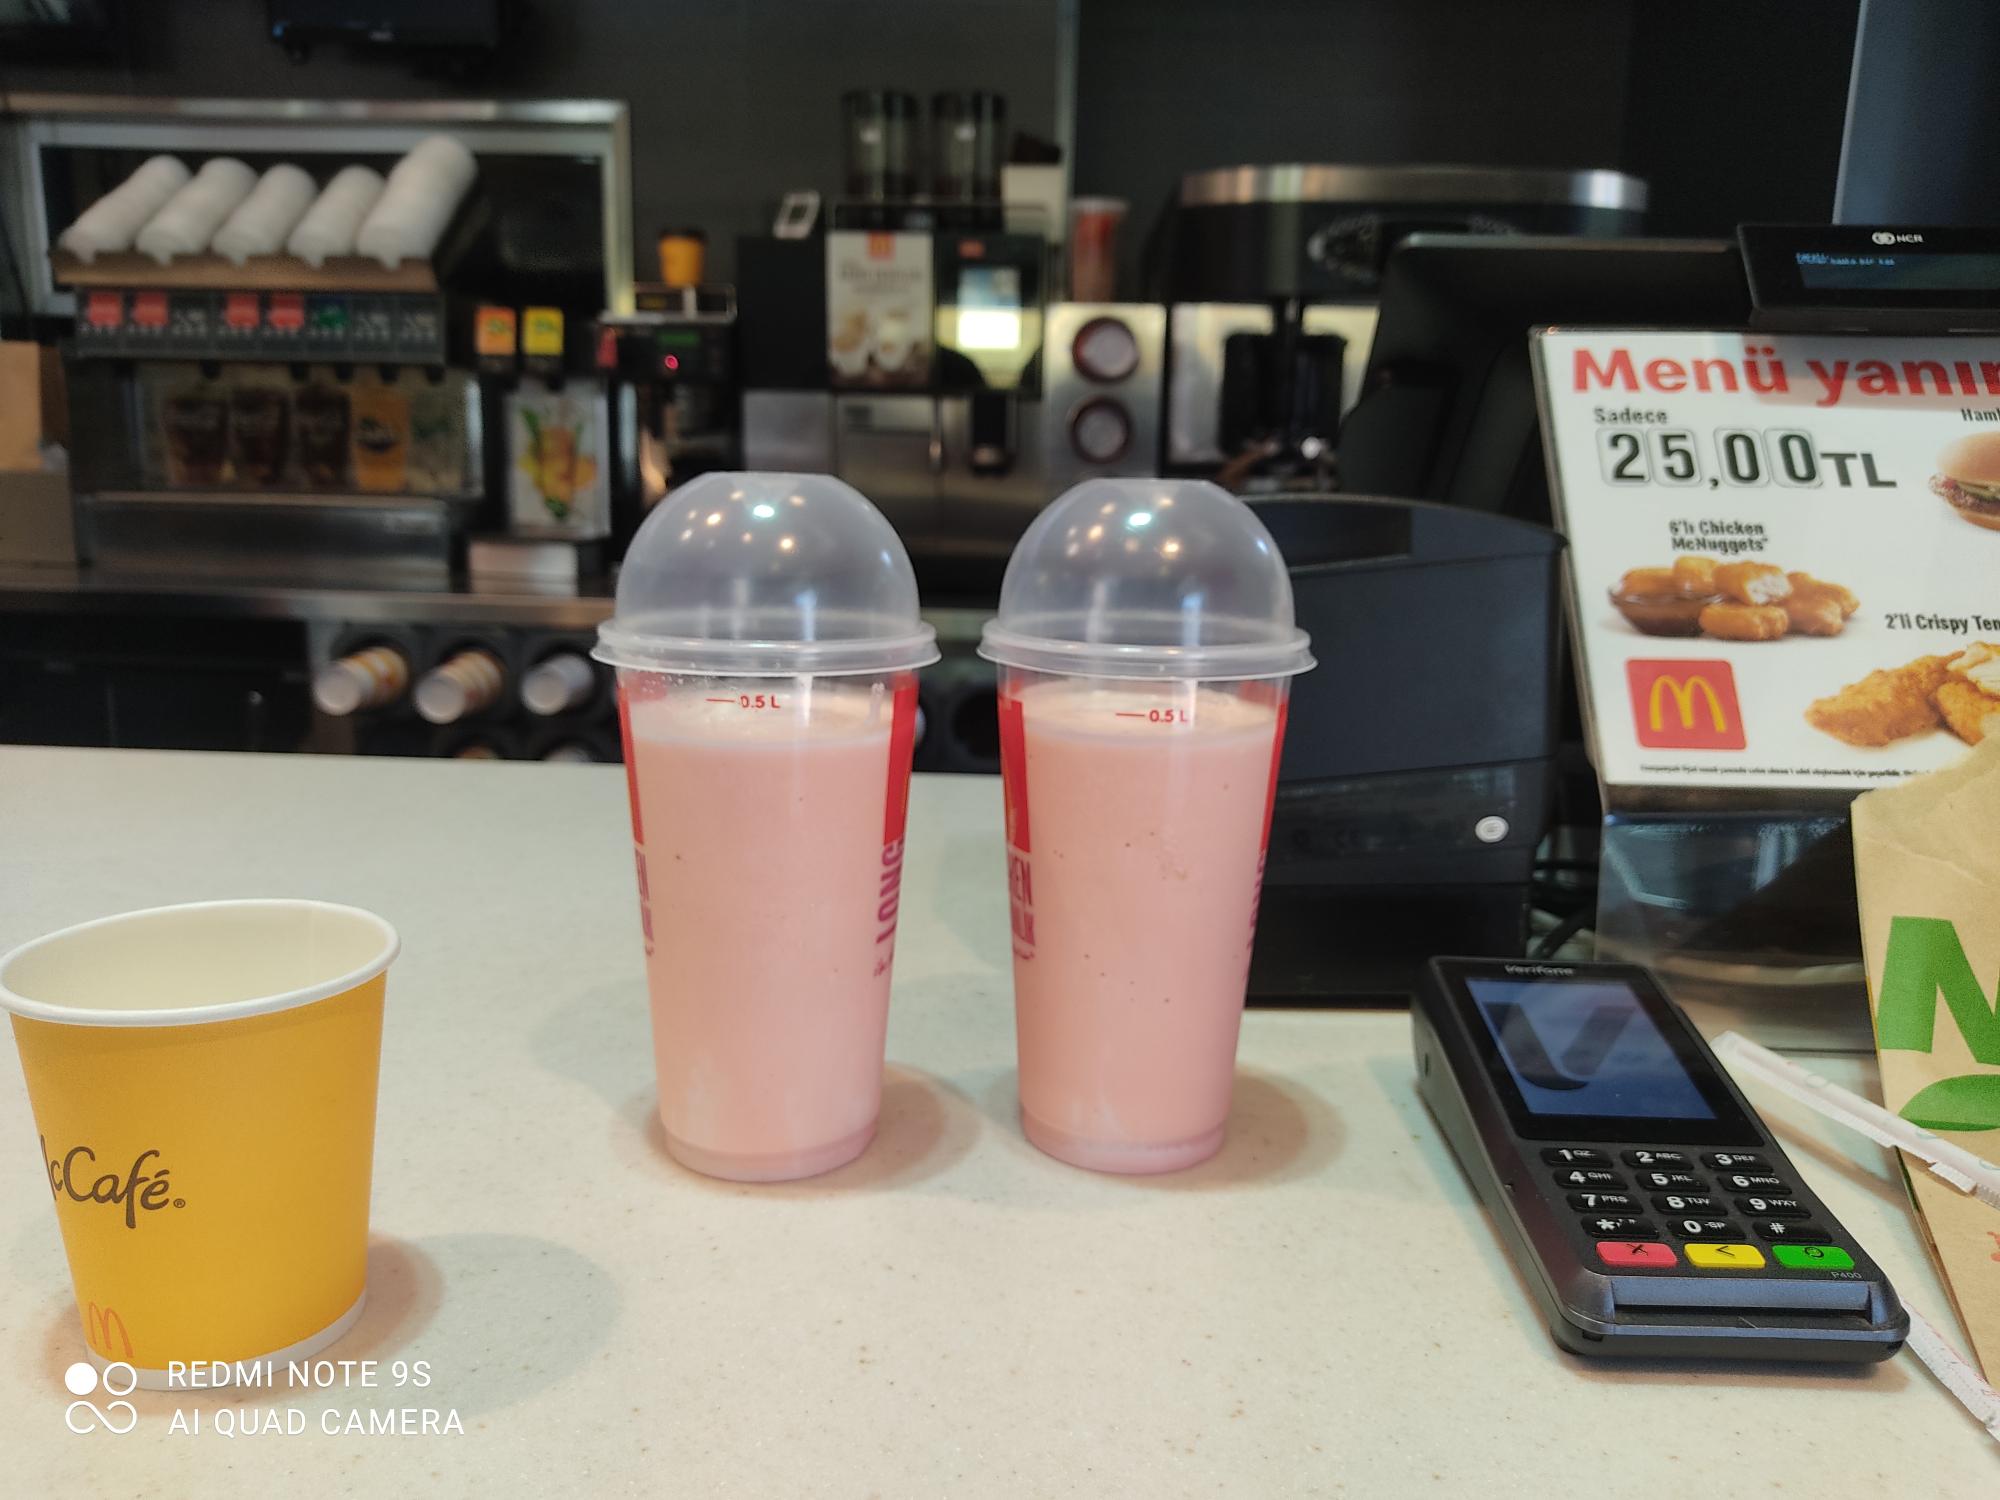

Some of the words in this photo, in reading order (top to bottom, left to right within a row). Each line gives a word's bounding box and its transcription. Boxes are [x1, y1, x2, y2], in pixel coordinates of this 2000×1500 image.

[1573, 345, 1789, 394] Menü
[1594, 407, 1667, 424] Sadece
[1961, 407, 2000, 422] Ham
[1699, 519, 1764, 535] Chicken
[1915, 613, 1968, 635] Crispy
[740, 695, 765, 709] 0.5
[770, 695, 781, 709] L
[1149, 709, 1174, 722] 0.5
[1504, 965, 1575, 977] Verifone
[1559, 1149, 1573, 1160] 1
[1635, 1151, 1654, 1163] 2
[1655, 1152, 1682, 1160] ABC
[1714, 1153, 1733, 1165] 3
[1733, 1154, 1757, 1163] DEF
[40, 1134, 170, 1229] cCafé
[1569, 1171, 1586, 1183] 4
[1587, 1171, 1612, 1181] GHI
[1651, 1173, 1669, 1185] 5
[1732, 1175, 1749, 1187] 6
[1750, 1176, 1780, 1184] MNO
[1581, 1193, 1596, 1207] 7
[1600, 1194, 1628, 1203] PRS
[1666, 1196, 1685, 1209] 8
[1685, 1197, 1711, 1206] TUV
[1749, 1198, 1767, 1210] 9
[1768, 1199, 1798, 1208] WXY
[1683, 1220, 1702, 1233] 0
[1830, 1271, 1862, 1279] P400
